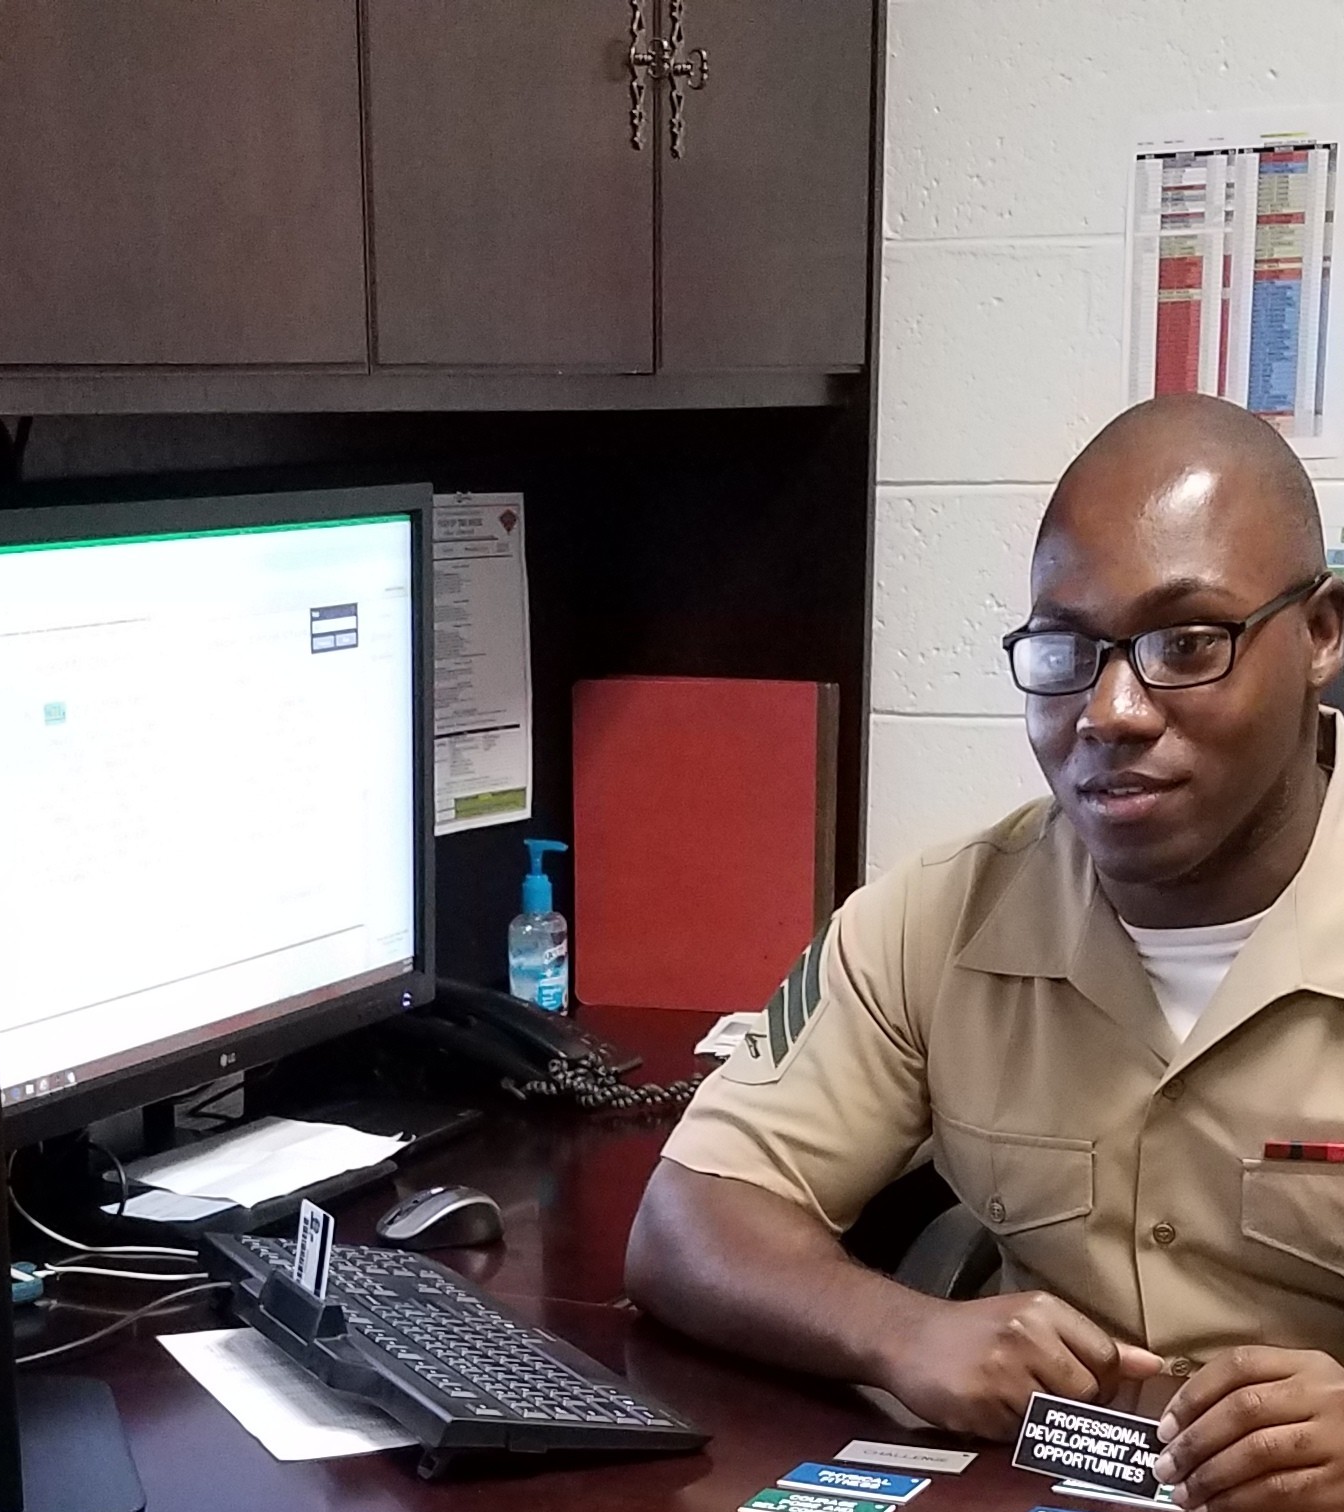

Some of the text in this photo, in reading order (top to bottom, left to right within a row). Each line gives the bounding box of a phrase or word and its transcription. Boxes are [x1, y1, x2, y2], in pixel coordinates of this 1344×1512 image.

[1045, 1409, 1150, 1449] PROFESSIONAL
[1025, 1422, 1160, 1469] DEVELOPMENT AND
[863, 1449, 949, 1463] CHALLENGE
[1033, 1443, 1145, 1484] OPPORTUNITIES
[818, 1469, 891, 1486] PHYSICAL
[819, 1476, 881, 1490] FITNESS
[789, 1493, 858, 1509] COURAGE
